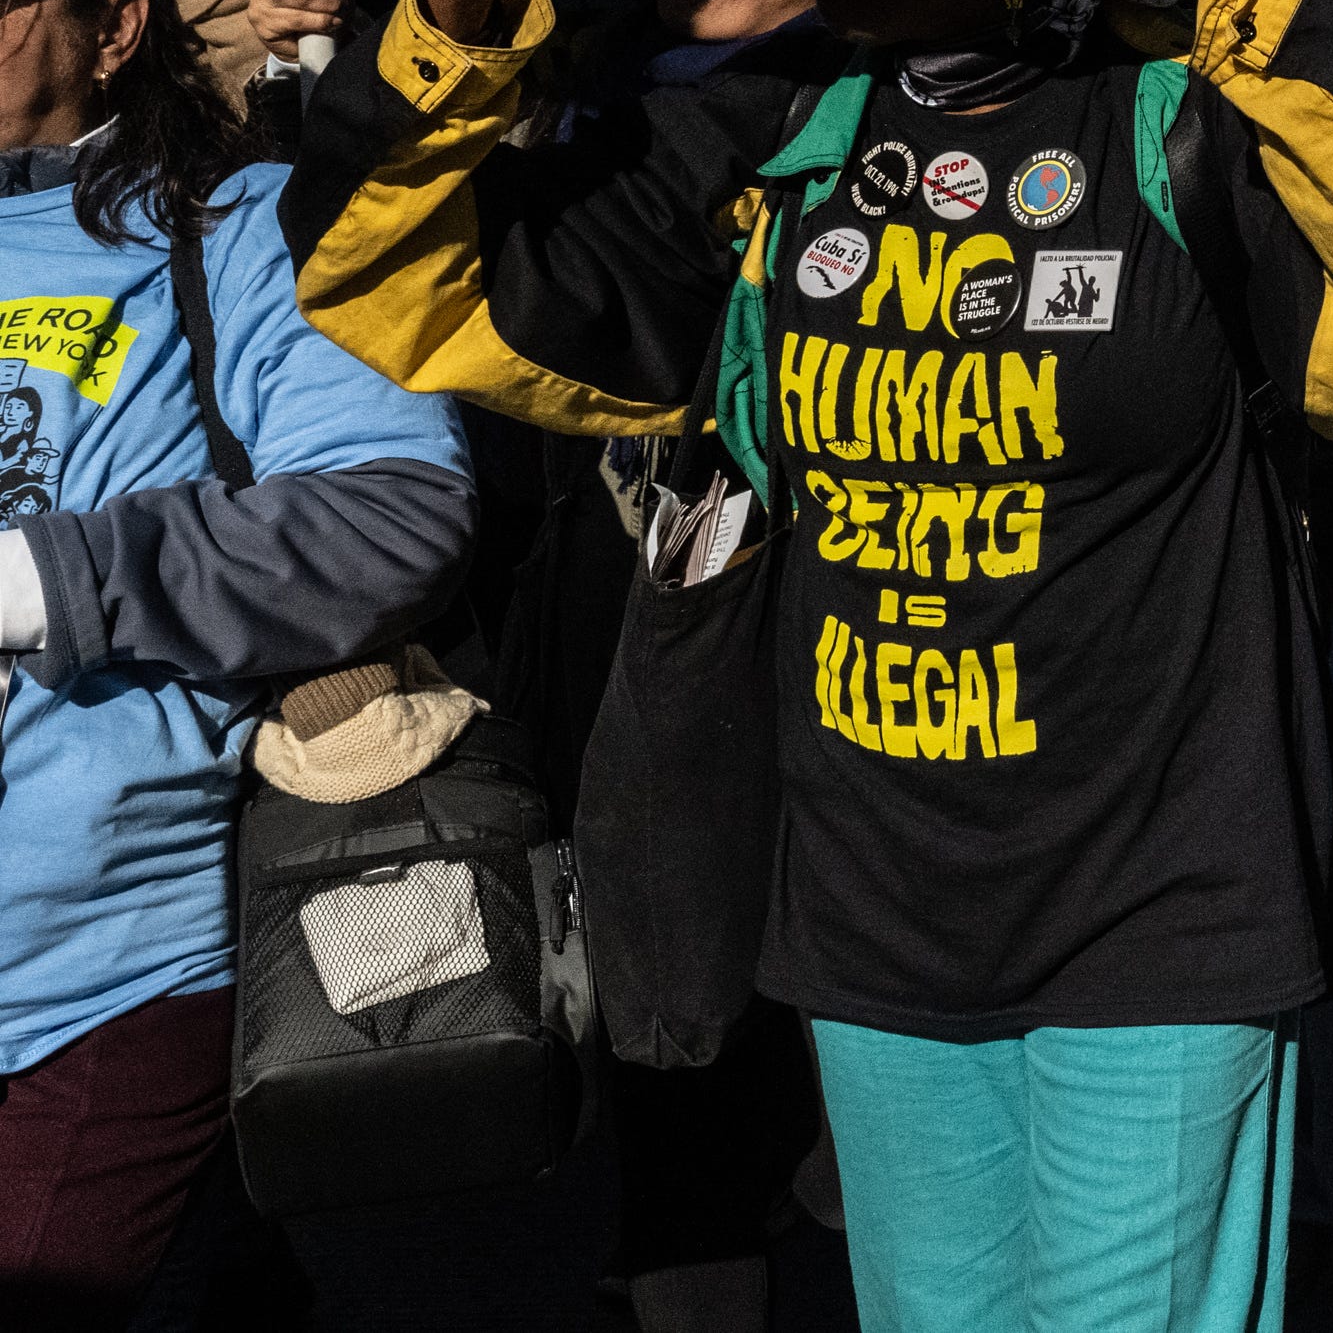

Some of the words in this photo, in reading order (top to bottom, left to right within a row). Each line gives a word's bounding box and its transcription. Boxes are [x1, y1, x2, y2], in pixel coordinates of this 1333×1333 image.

[861, 143, 882, 165] FIGHT
[883, 140, 909, 155] POLICE
[900, 150, 917, 197] BRUTALITY!
[934, 158, 970, 178] STOP
[1032, 150, 1058, 164] FREE
[1058, 152, 1076, 168] ALL
[882, 178, 900, 197] 1996
[929, 176, 947, 188] INS
[931, 177, 981, 197] detentions
[851, 182, 864, 208] WEAR
[860, 202, 887, 217] BLACK!
[1008, 176, 1030, 225] POLITICAL
[1034, 181, 1082, 226] PRISONERS
[815, 235, 847, 258] Cuba
[847, 248, 867, 265] Sí
[806, 250, 842, 270] BLOQUEO
[841, 264, 855, 276] NO
[961, 282, 970, 292] A
[970, 274, 1013, 290] WOMAN'S
[959, 302, 968, 312] IS
[968, 300, 979, 310] IN
[980, 296, 996, 308] THE
[960, 288, 987, 302] PLACE
[957, 305, 1001, 322] STRUGGLE
[779, 332, 1065, 465] HUMAN
[805, 469, 1044, 582] BEING
[877, 588, 946, 627] IS
[815, 615, 1036, 761] ILLEGAL
